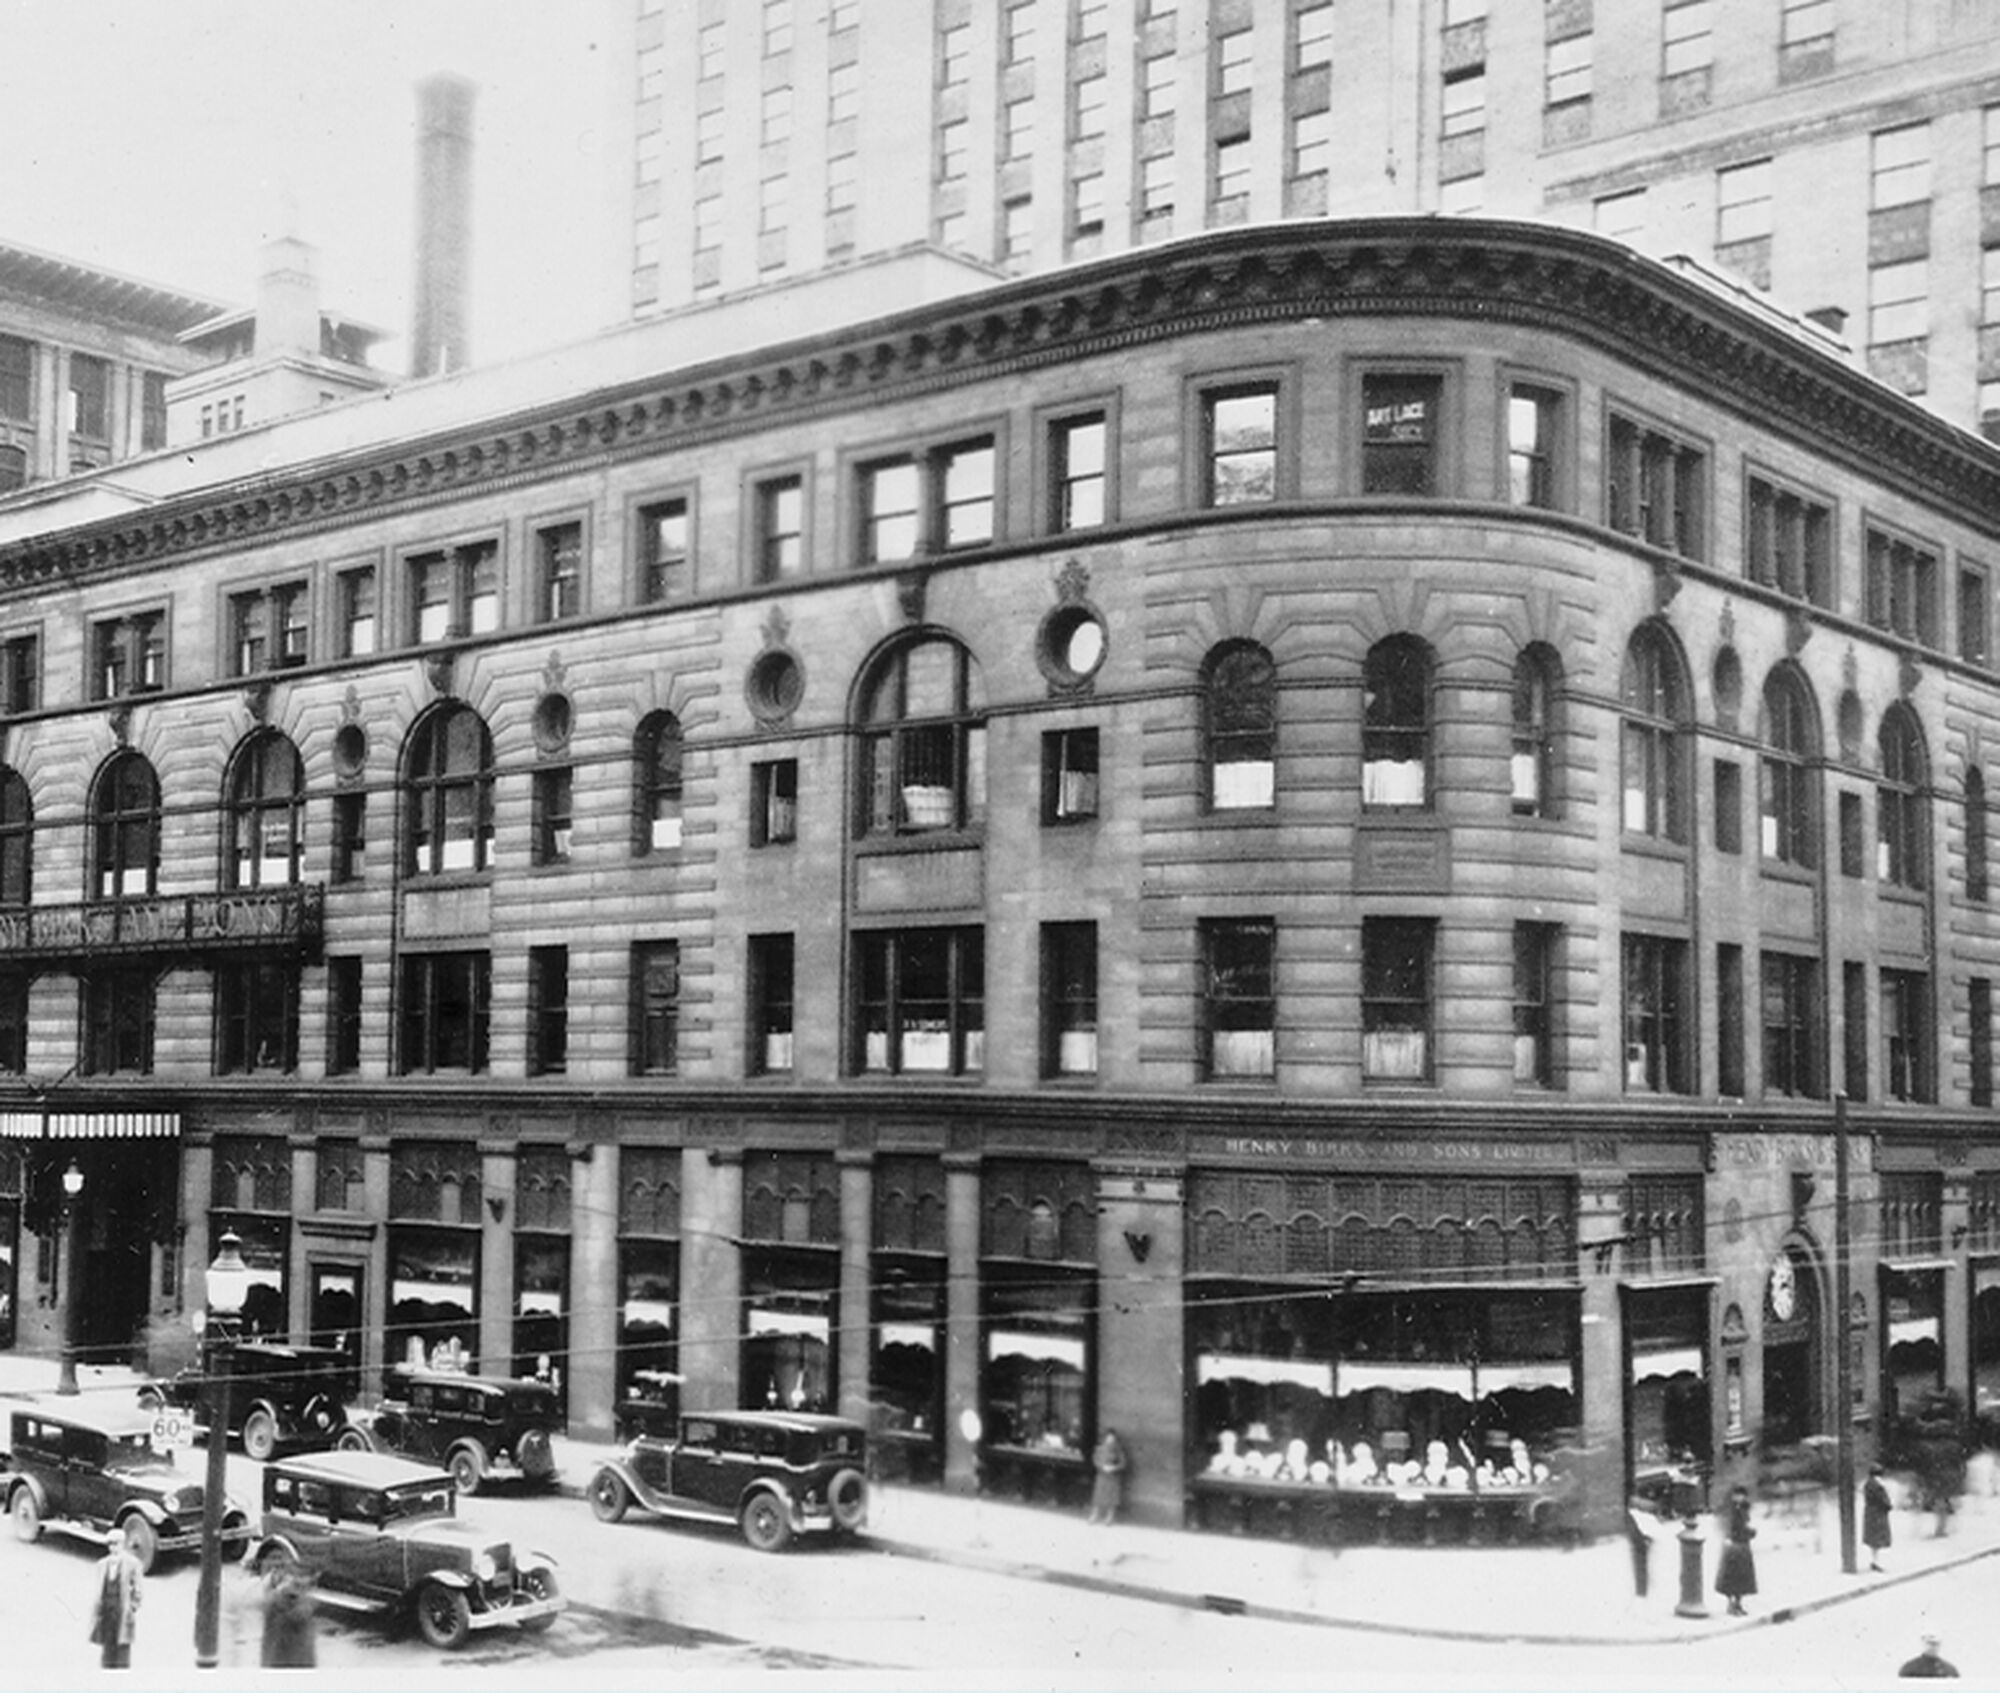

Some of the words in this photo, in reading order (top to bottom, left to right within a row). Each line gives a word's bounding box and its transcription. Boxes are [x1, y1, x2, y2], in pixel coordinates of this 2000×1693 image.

[1225, 1138, 1293, 1155] HENRY
[1432, 1143, 1481, 1160] SONS
[153, 1417, 181, 1438] 60
